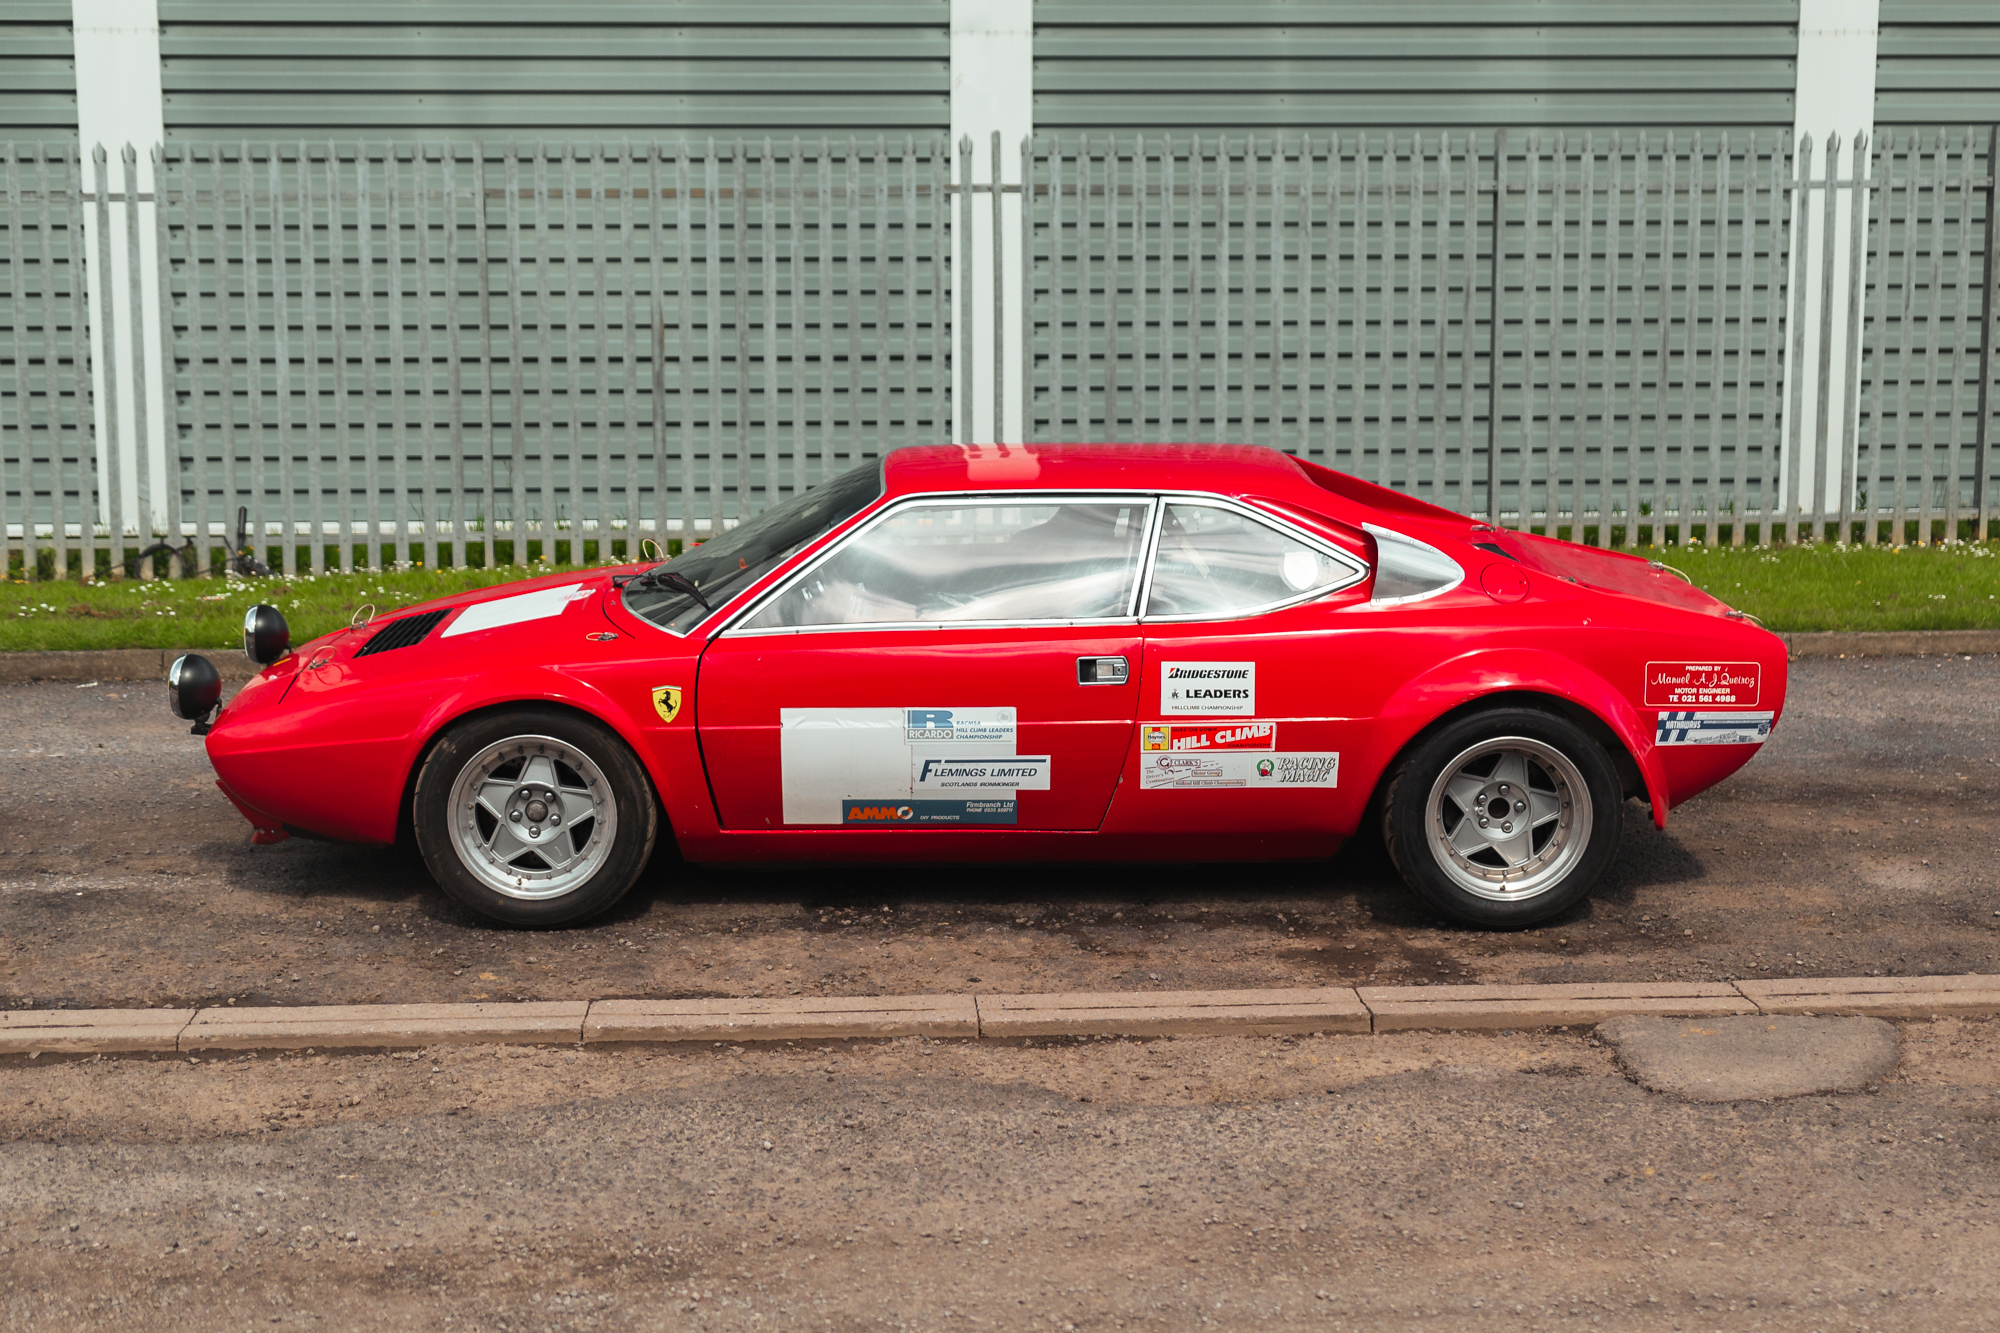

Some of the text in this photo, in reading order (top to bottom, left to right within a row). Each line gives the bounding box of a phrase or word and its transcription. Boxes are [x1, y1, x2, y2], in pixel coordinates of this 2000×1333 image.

[1167, 667, 1250, 679] BRIDGESTONE
[1650, 672, 1691, 686] Manuel
[1185, 688, 1250, 699] LEADERS
[1674, 687, 1731, 695] MOTOR ENGINEER
[1681, 695, 1696, 703] 021
[1698, 695, 1713, 703] 561
[1715, 695, 1737, 703] 4988
[908, 729, 953, 739] RICARDO
[1172, 724, 1271, 751] HILL CLIMB
[919, 759, 1038, 782] FLEMINGS LIMITED
[1277, 757, 1336, 771] RACING
[1279, 769, 1332, 783] MAGIC
[847, 805, 914, 821] AMMO
